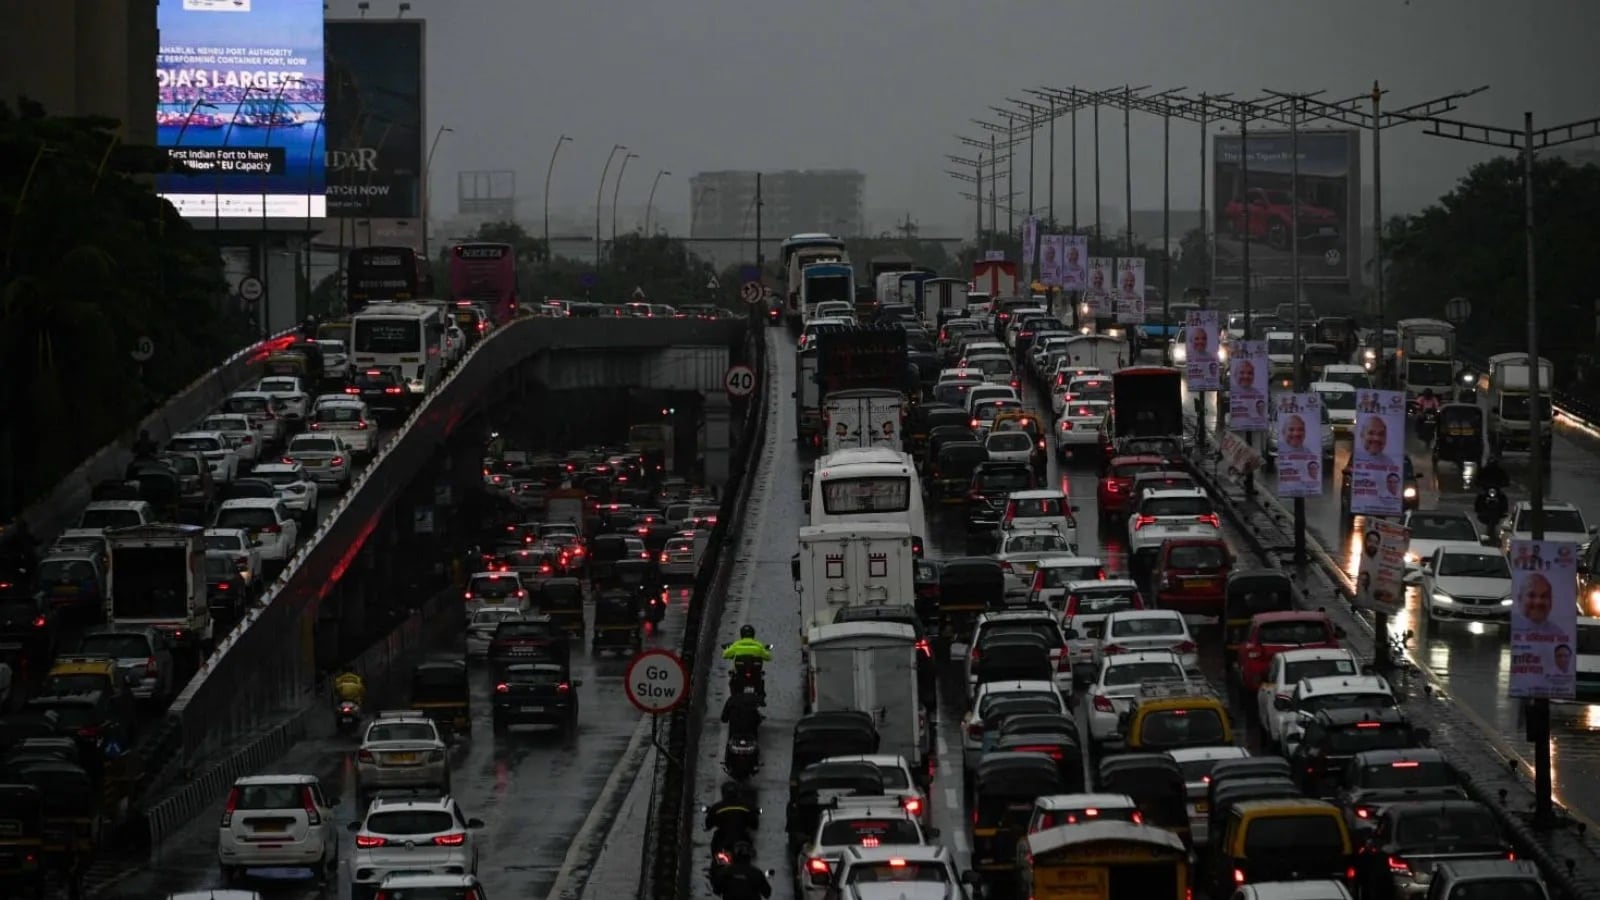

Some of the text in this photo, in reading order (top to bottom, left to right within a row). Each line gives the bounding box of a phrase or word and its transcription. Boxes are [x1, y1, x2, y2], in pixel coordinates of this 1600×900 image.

[197, 47, 225, 55] NEHRU
[226, 48, 246, 56] PORT
[248, 48, 293, 57] AUTHORITY
[165, 55, 216, 64] PERFORMING
[217, 56, 262, 65] CONTAINER
[287, 58, 308, 66] NOW
[212, 69, 304, 89] LARGEST
[189, 149, 216, 159] Indian
[237, 150, 247, 159] to
[248, 150, 269, 160] have
[359, 185, 390, 196] NOW
[729, 372, 753, 389] 40
[646, 666, 668, 680] Go
[637, 683, 675, 697] Slow
